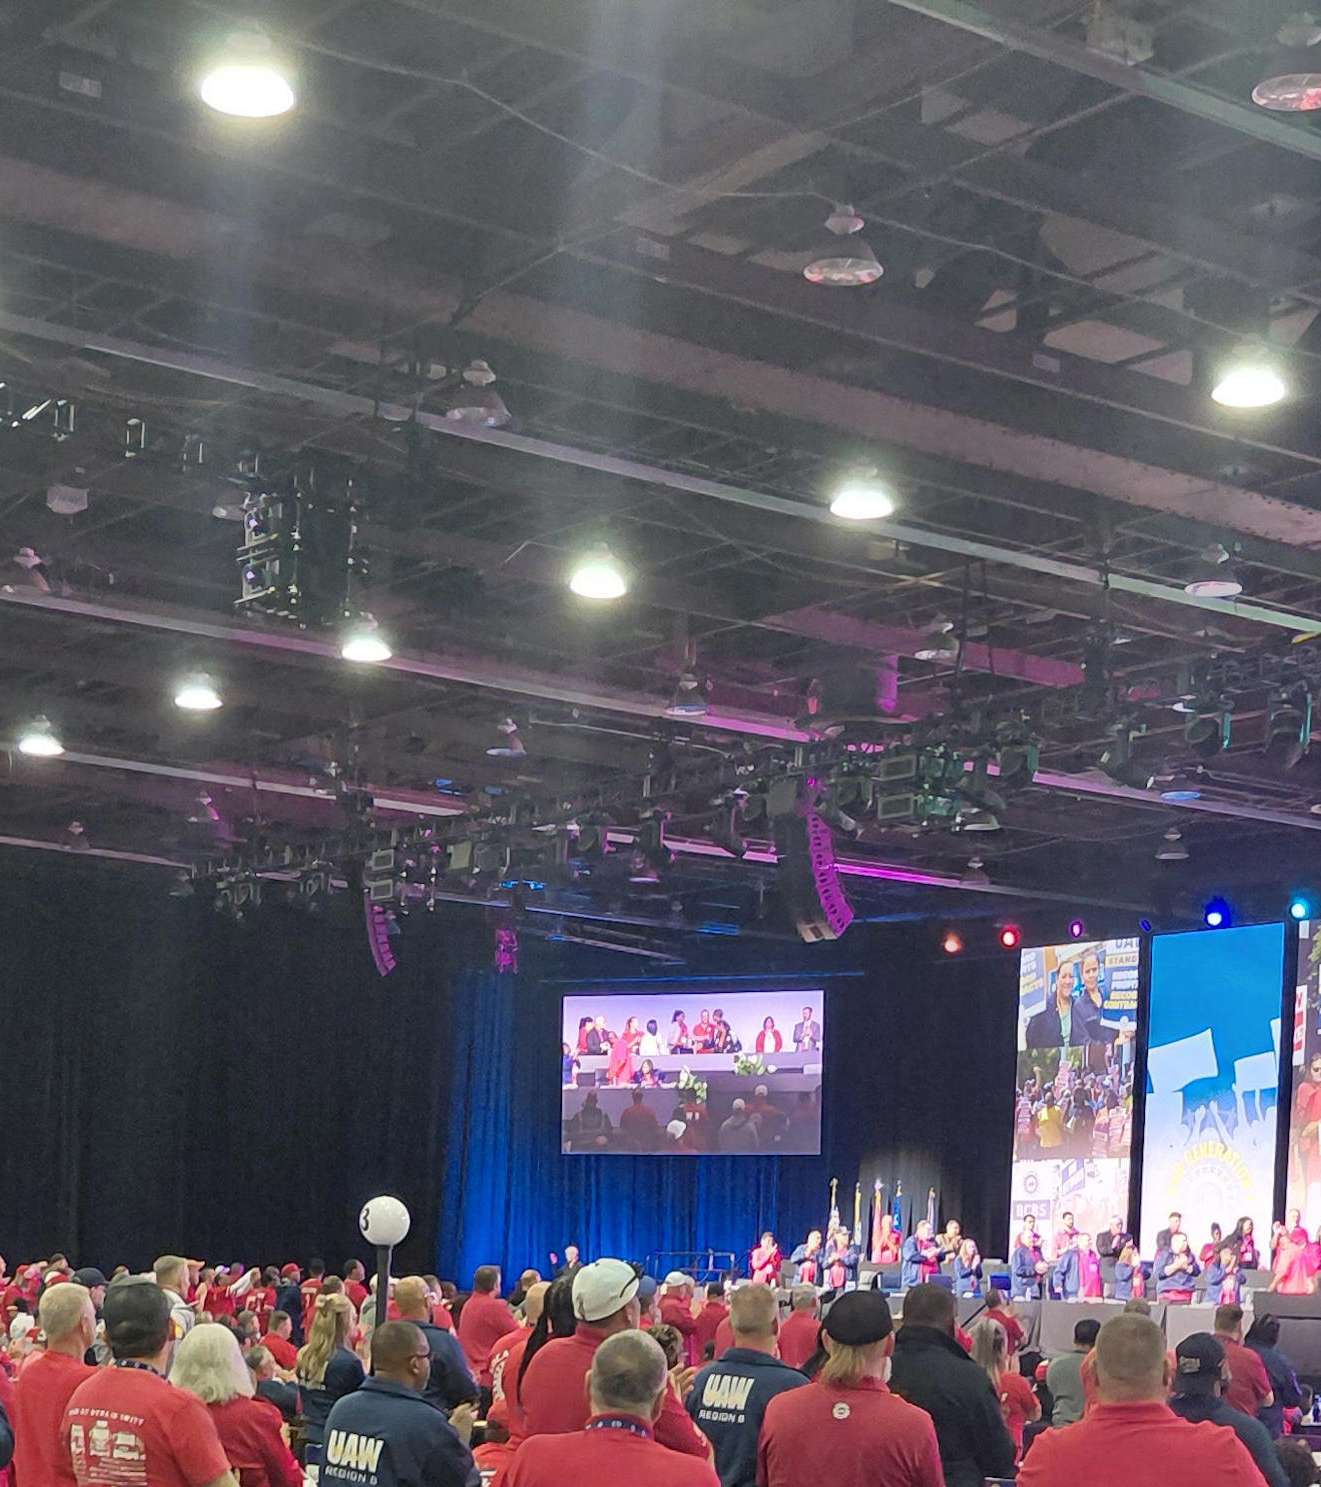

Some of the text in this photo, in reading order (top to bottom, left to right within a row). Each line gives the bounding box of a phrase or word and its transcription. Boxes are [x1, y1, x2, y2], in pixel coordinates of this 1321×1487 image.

[361, 1207, 370, 1231] 3
[702, 1373, 755, 1410] UAW
[327, 1429, 384, 1474] UAW
[325, 1465, 367, 1483] REGION
